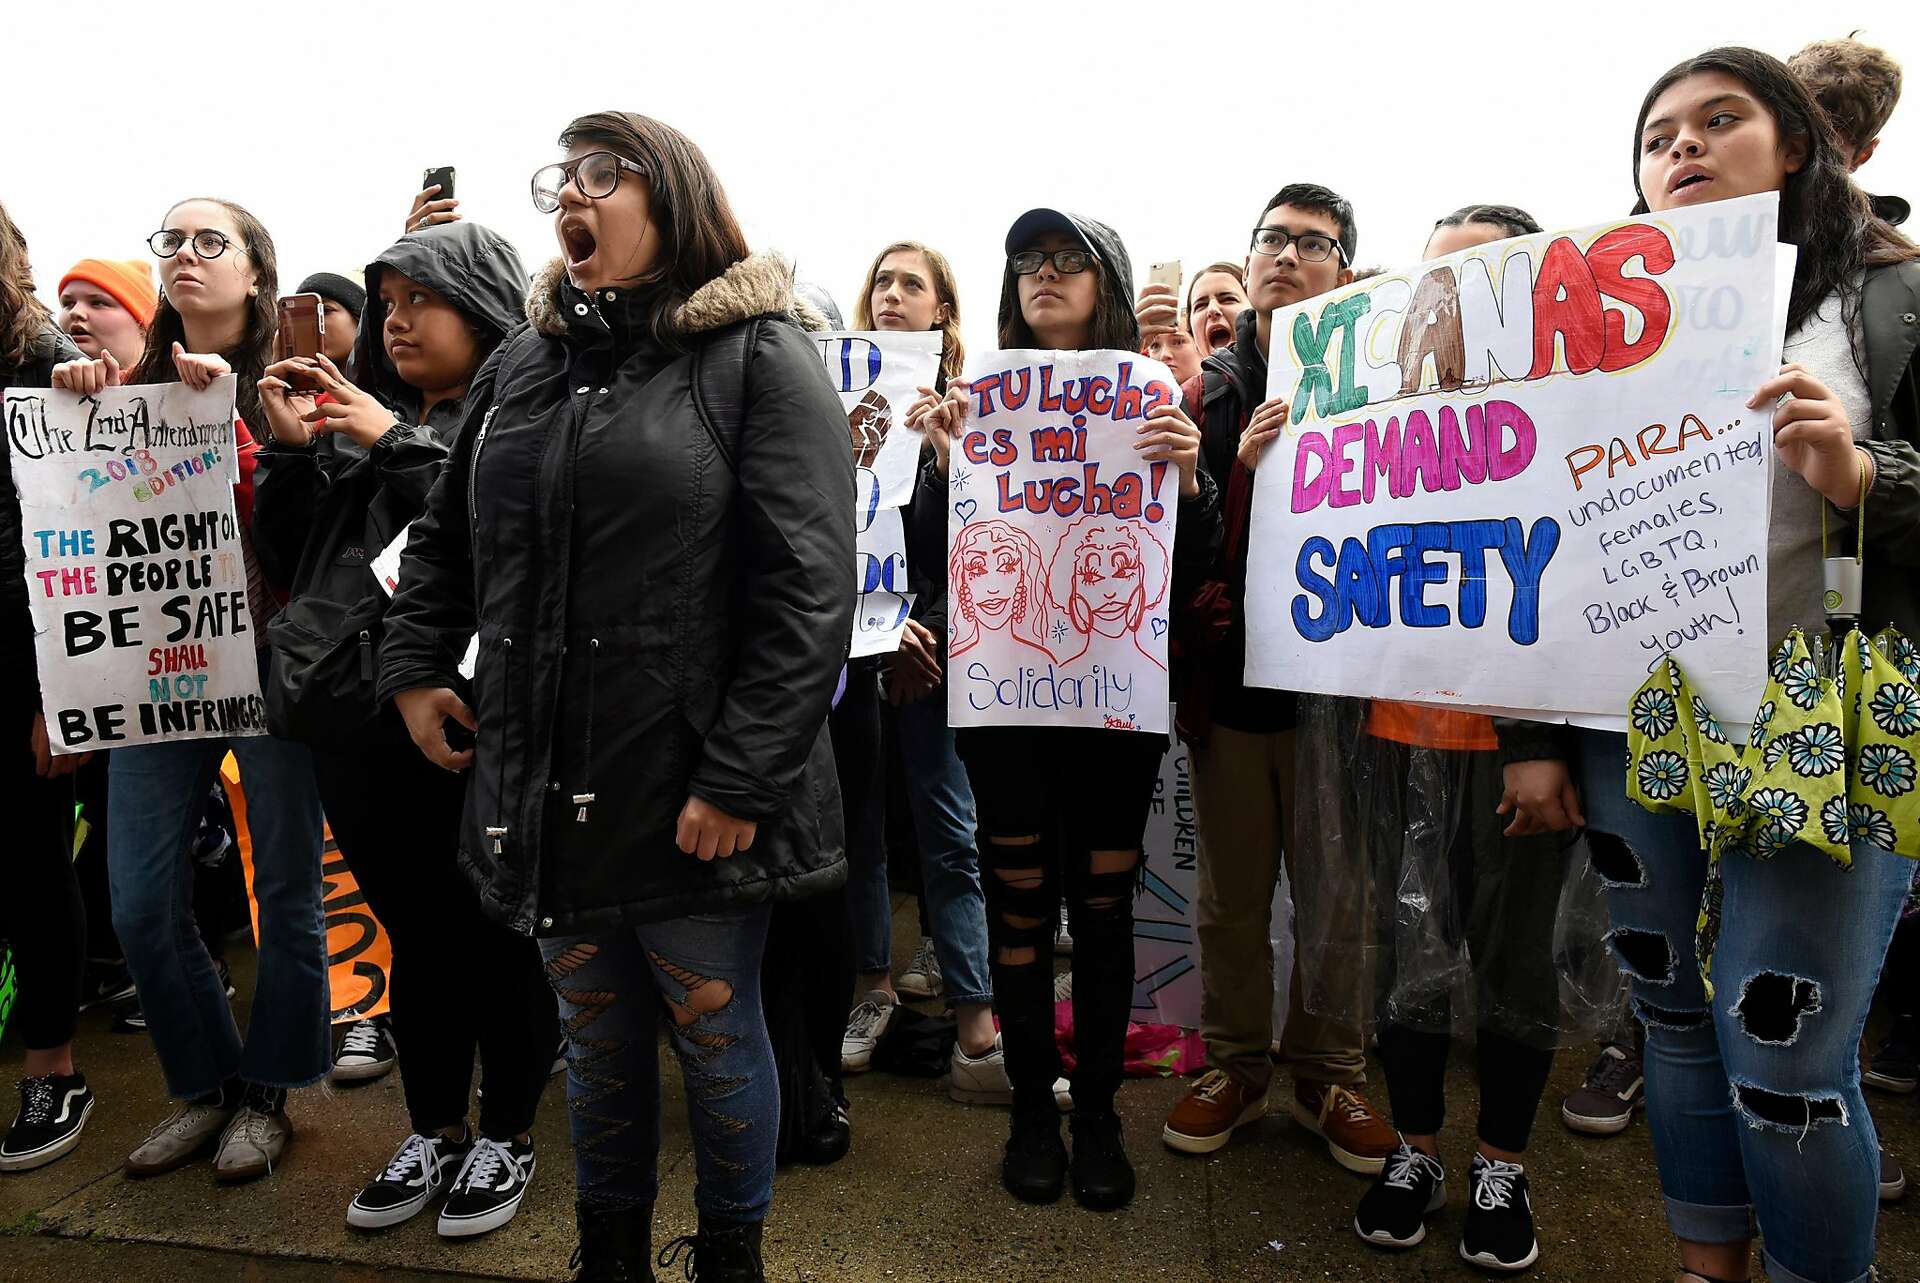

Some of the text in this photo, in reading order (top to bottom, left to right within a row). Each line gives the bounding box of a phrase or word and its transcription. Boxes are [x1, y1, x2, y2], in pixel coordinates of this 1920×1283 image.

[1290, 223, 1675, 425] XICANAS
[969, 366, 1031, 418] TU
[6, 396, 76, 459] The
[79, 394, 129, 451] 2nd
[962, 414, 1088, 467] es mi
[1290, 399, 1537, 514] DEMAND
[1564, 413, 1741, 492] PARA...
[80, 449, 158, 493] 2018
[1568, 431, 1764, 527] undocumented,
[33, 529, 96, 559] THE
[105, 511, 219, 558] RIGHT
[1599, 491, 1723, 555] females,
[36, 566, 98, 598] THE
[106, 554, 212, 596] PEOPLE
[1290, 515, 1561, 646] SAFETY
[1582, 594, 1659, 634] Black
[1681, 553, 1760, 599] Brown
[64, 590, 247, 657] BE SAFE
[1640, 585, 1744, 674] youth!
[148, 644, 209, 676] SHALL
[149, 674, 209, 703] NOT
[967, 663, 1133, 713] Solidarity
[58, 703, 126, 746] BE
